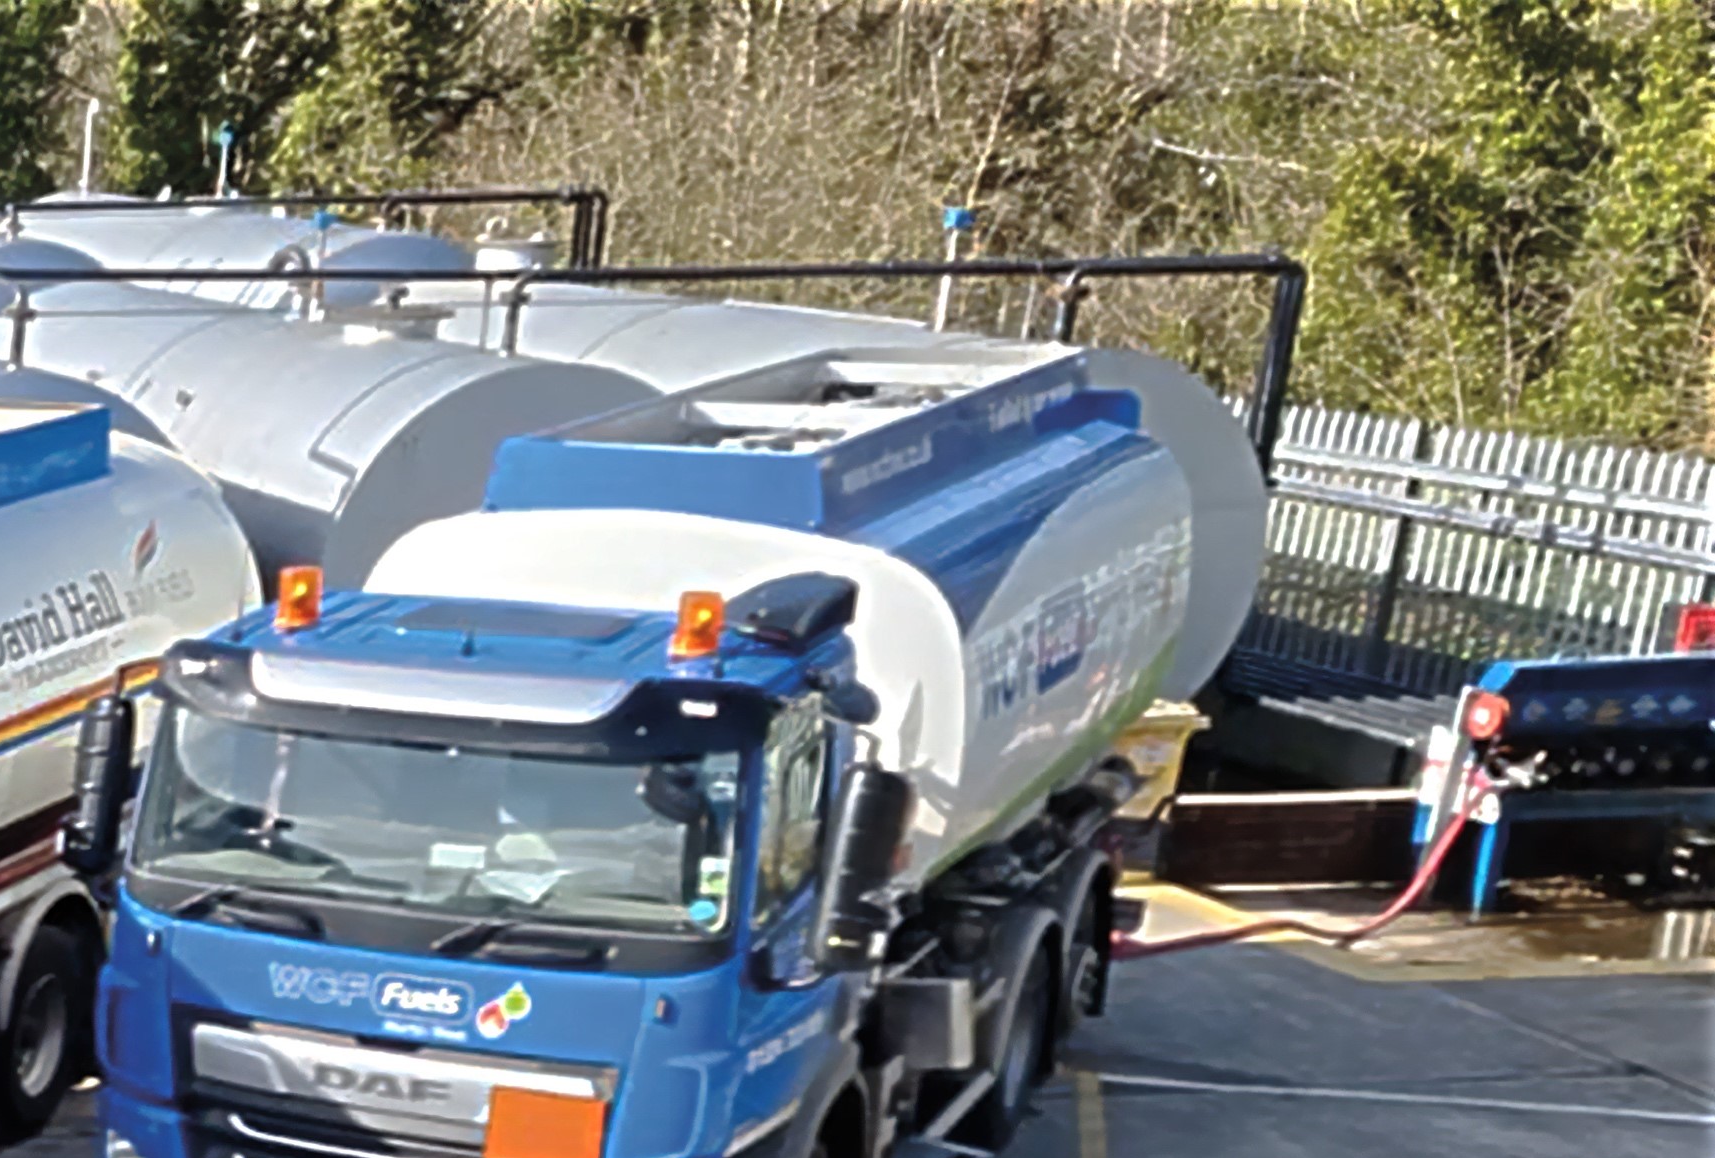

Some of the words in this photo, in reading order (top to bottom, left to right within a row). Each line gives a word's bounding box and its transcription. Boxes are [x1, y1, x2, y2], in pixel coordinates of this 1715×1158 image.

[56, 570, 125, 639] Hall
[268, 961, 369, 1007] WCF
[381, 982, 463, 1015] Fuels
[313, 1063, 452, 1102] DAF
